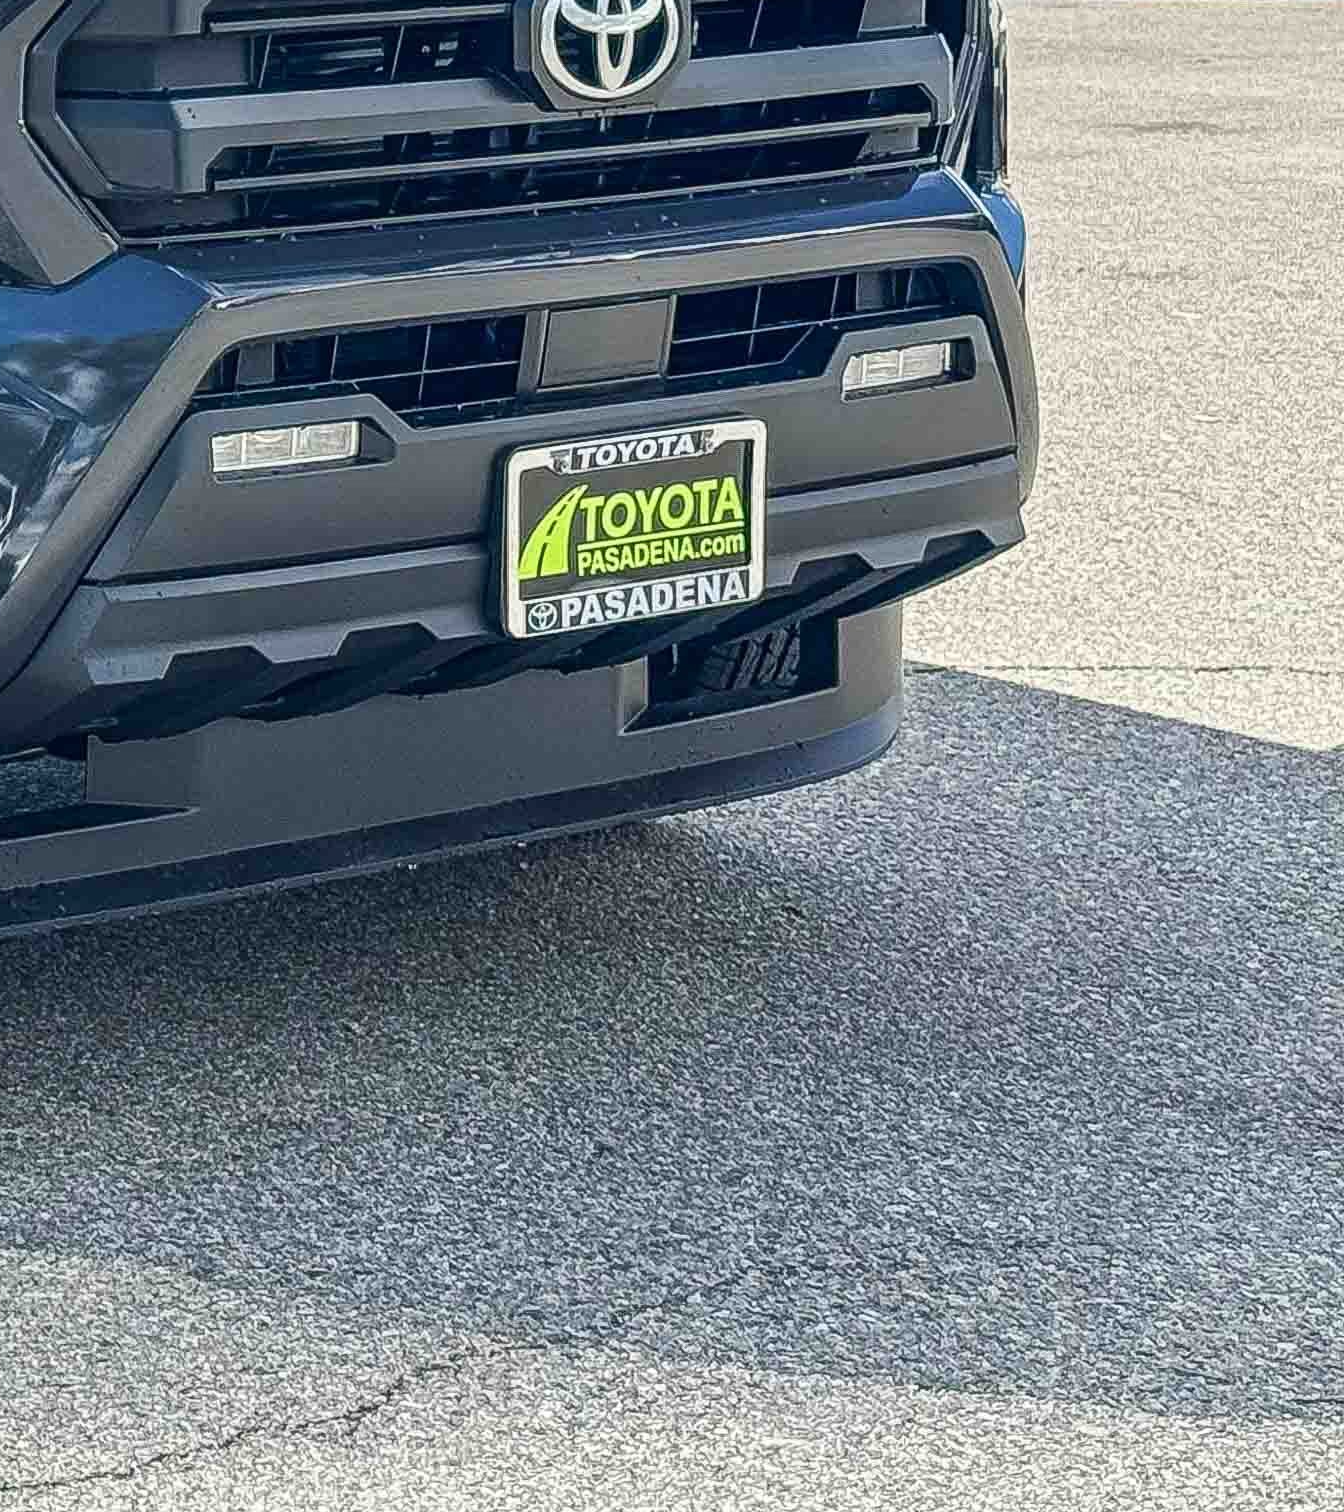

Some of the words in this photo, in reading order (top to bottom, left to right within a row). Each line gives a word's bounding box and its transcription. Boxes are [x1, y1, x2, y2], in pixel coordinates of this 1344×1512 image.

[577, 433, 695, 468] TOYOTA
[579, 476, 744, 542] TOYOTA
[577, 531, 746, 577] PASADENA.com
[561, 570, 747, 627] PASADENA
